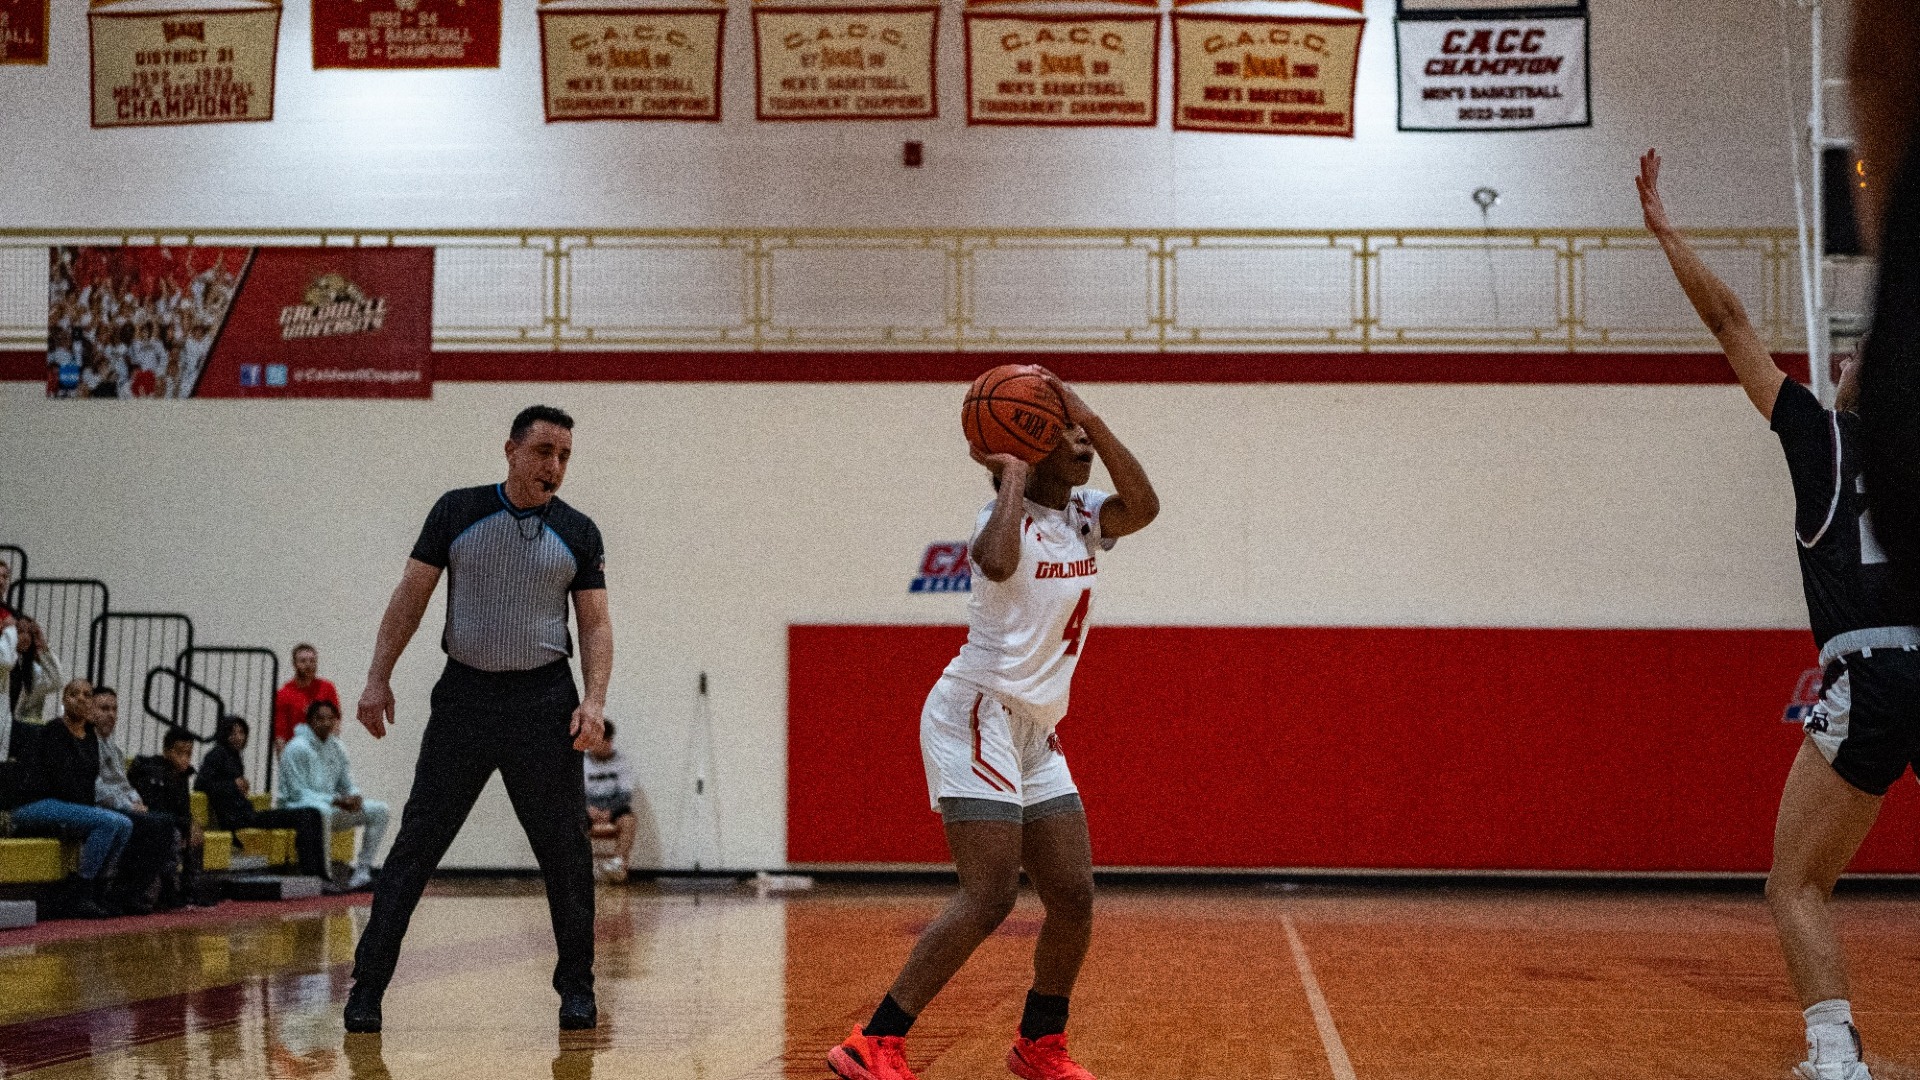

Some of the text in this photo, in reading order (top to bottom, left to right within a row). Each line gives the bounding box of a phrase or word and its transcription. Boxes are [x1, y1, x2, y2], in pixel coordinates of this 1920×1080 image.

[1001, 27, 1125, 53] C.A.C.C.
[1203, 28, 1330, 57] C.A.C.C.
[1441, 28, 1546, 54] CACC
[135, 50, 207, 65] DISTRICT
[1424, 57, 1565, 76] CHAMPION
[612, 76, 694, 92] BASKETBALL
[826, 76, 910, 91] BASKETBALL
[1042, 81, 1126, 97] BASKETBALL
[1422, 85, 1564, 100] MEN'S BASKETBALL
[117, 98, 248, 119] CHAMPIONS
[920, 541, 972, 576] CA
[1035, 556, 1098, 579] CALDWE
[1061, 587, 1091, 655] 4
